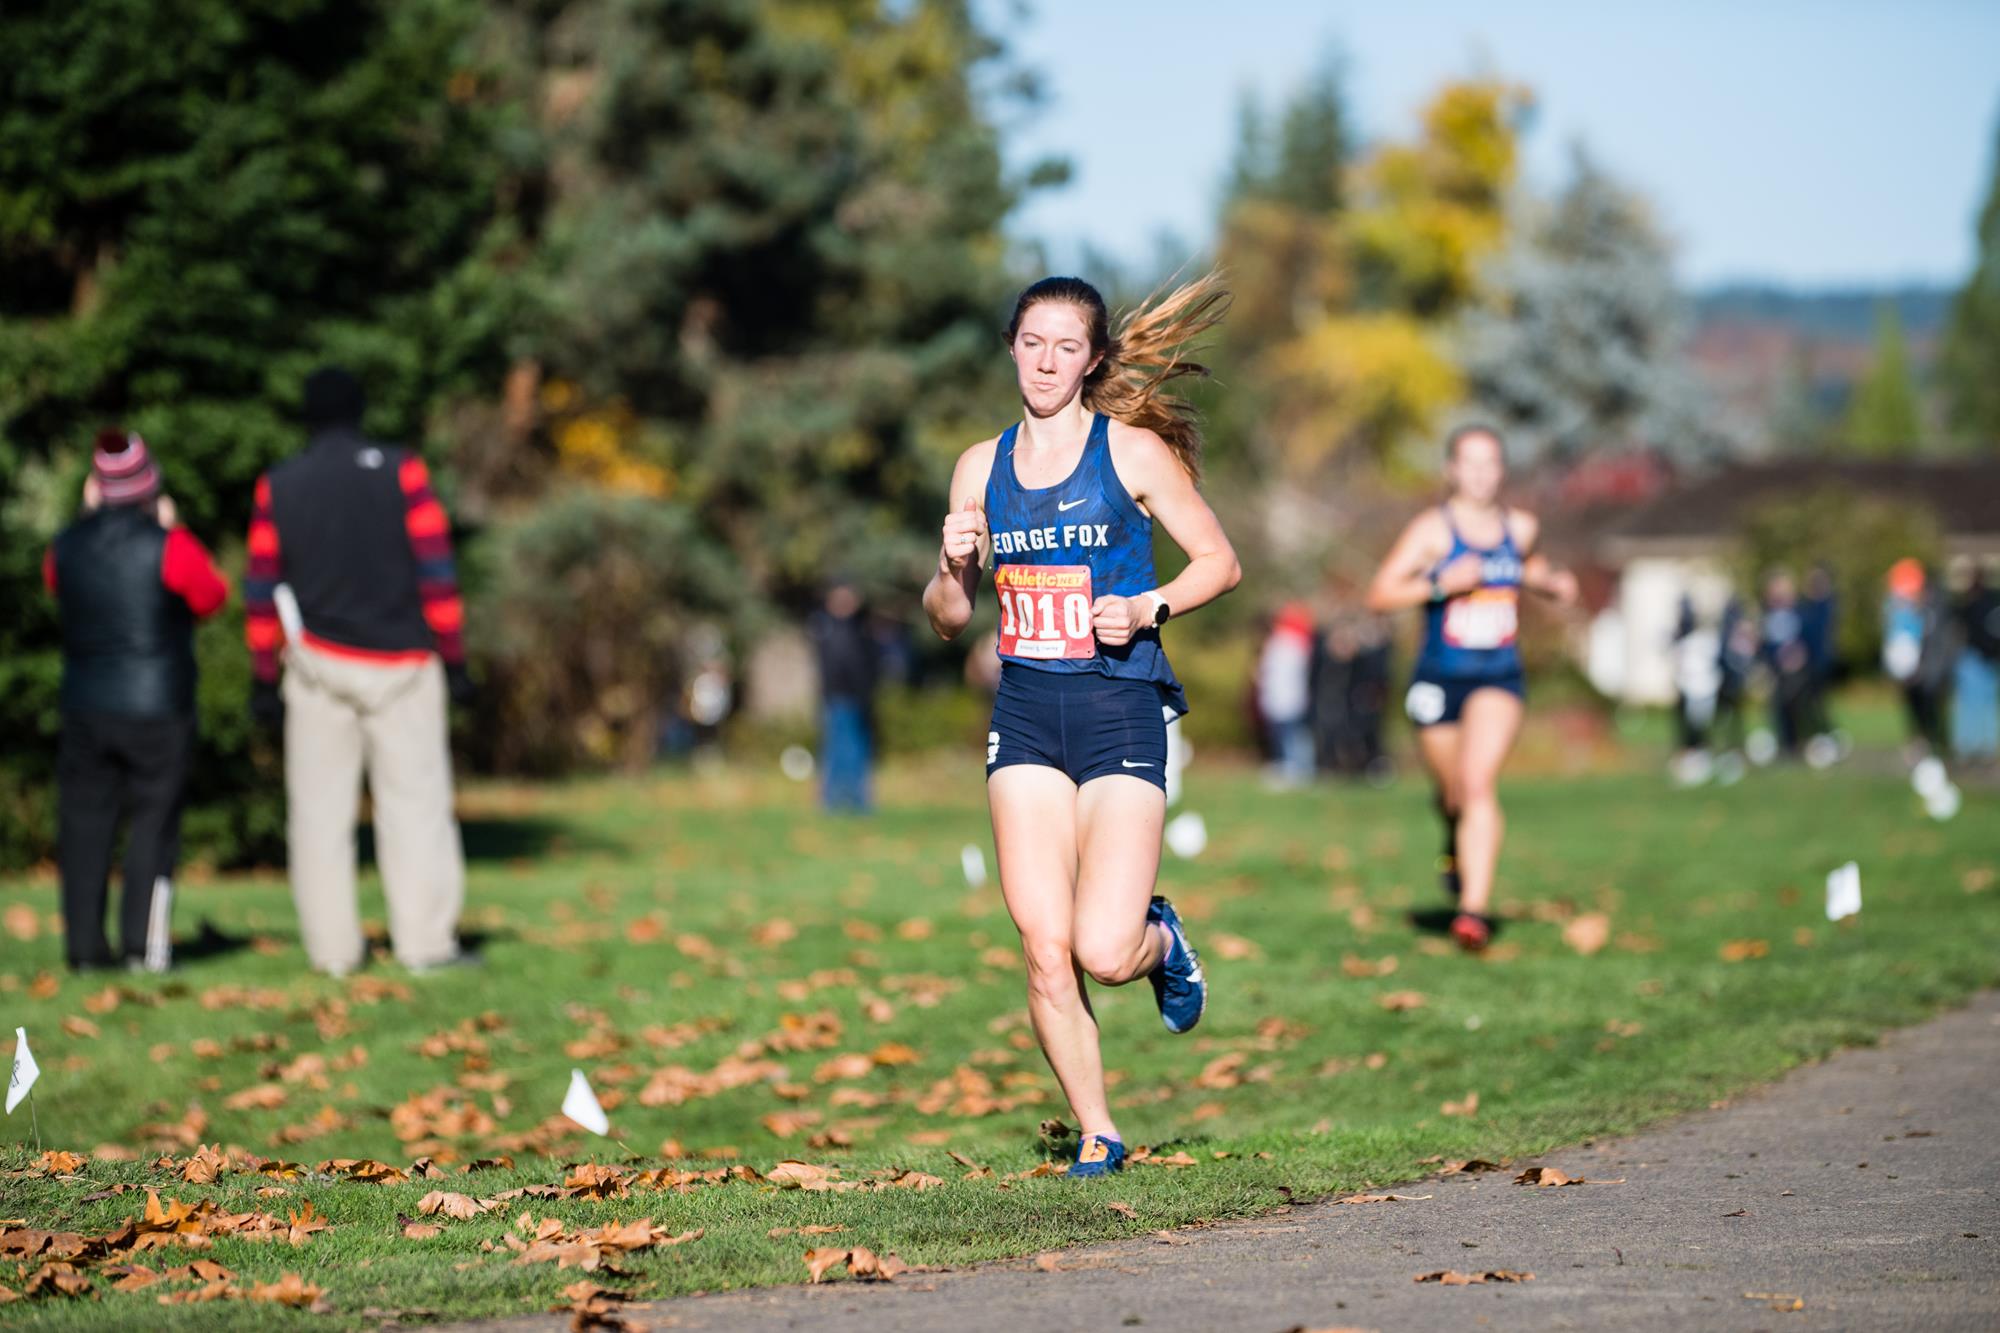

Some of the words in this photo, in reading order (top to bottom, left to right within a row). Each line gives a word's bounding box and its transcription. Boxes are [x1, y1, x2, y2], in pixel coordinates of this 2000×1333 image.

[992, 527, 1059, 554] EORGE
[1063, 525, 1109, 547] FOX
[1002, 591, 1090, 639] 1010
